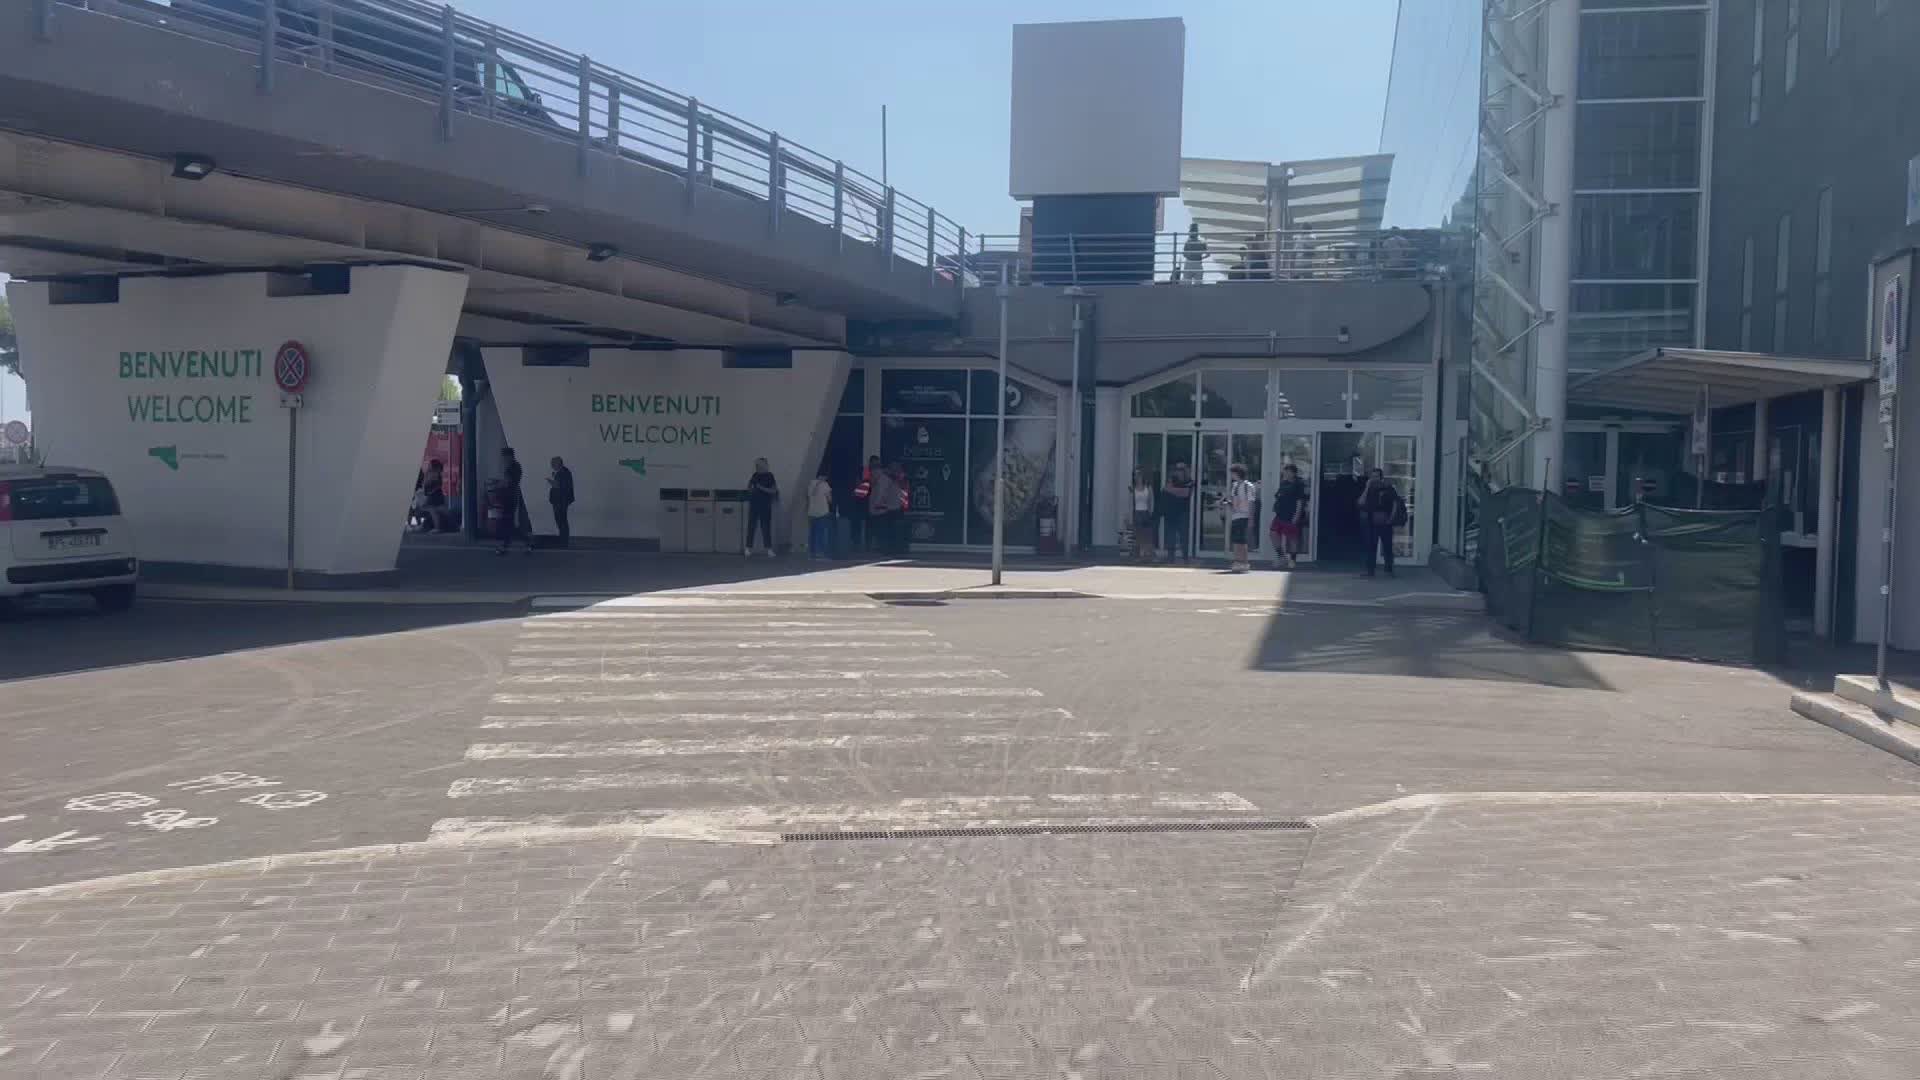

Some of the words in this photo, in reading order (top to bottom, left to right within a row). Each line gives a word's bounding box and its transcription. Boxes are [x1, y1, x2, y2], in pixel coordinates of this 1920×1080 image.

[119, 349, 262, 378] BENVENUTI
[128, 394, 253, 424] WELCOME
[591, 394, 720, 416] BENVENUTI
[599, 423, 713, 445] WELCOME
